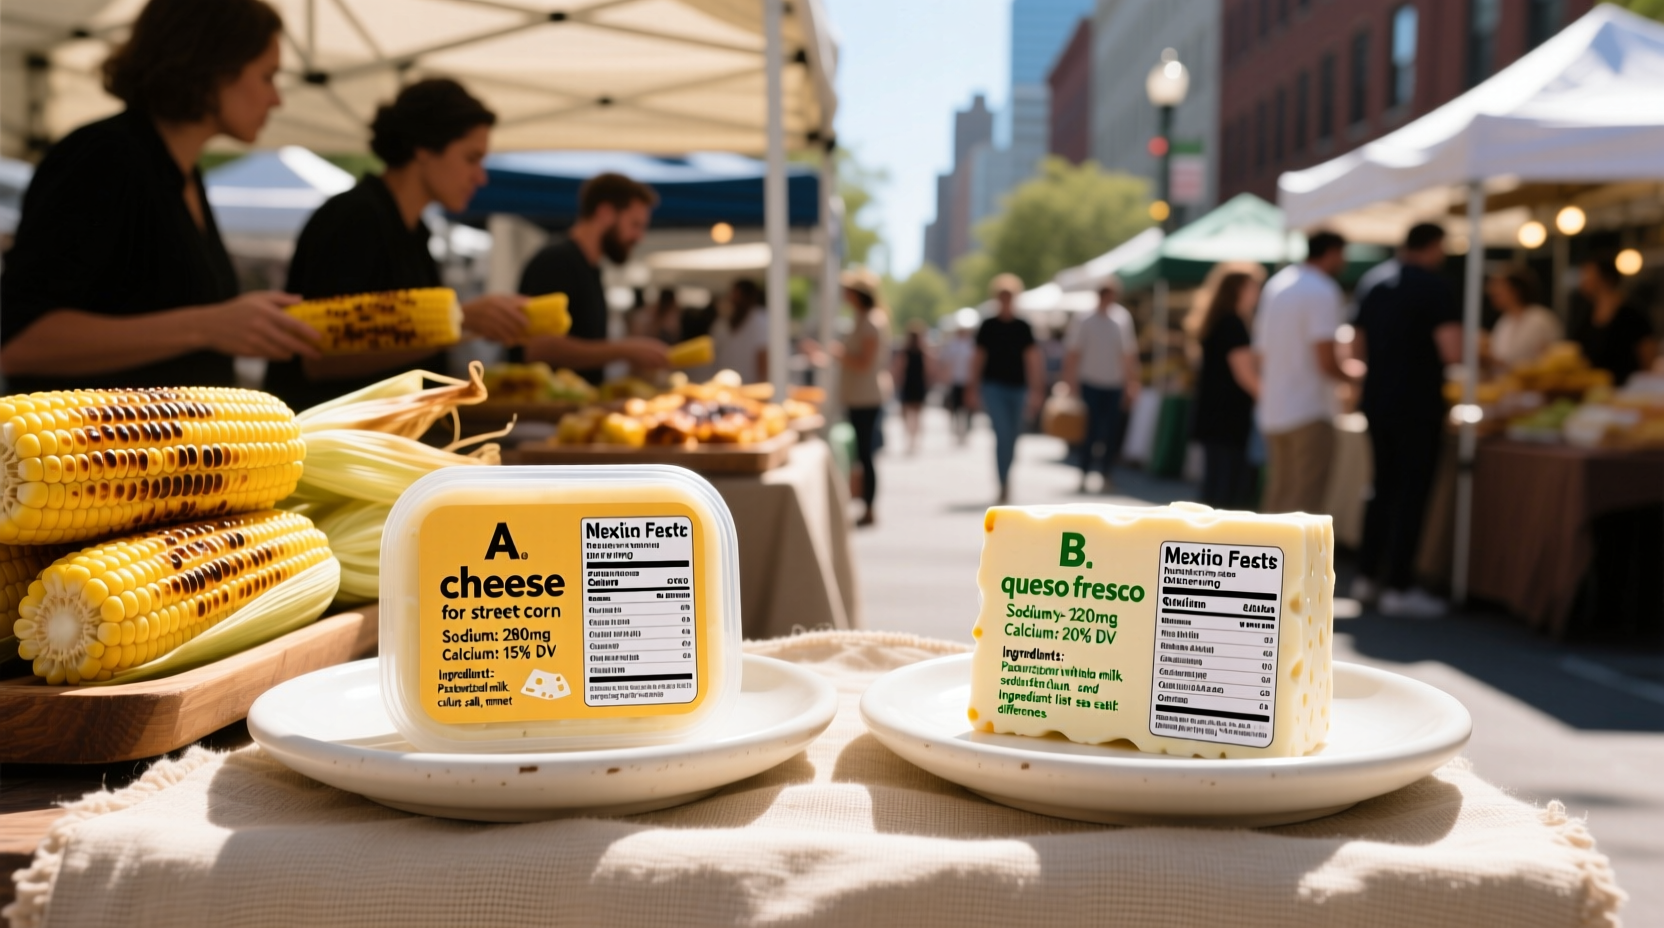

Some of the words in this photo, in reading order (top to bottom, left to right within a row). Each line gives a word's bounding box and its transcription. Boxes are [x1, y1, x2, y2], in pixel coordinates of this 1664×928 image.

[1059, 532, 1093, 569] B.
[440, 566, 565, 598] cheese
[1001, 576, 1069, 599] queso
[1073, 575, 1145, 603] fresco
[442, 604, 466, 620] for
[471, 605, 520, 619] street
[524, 606, 561, 618] corn
[442, 628, 499, 643] Sodium:
[1004, 623, 1059, 640] Calcium:
[1062, 627, 1092, 643] 20%
[1096, 629, 1117, 645] DV
[442, 647, 499, 661] Calcium:
[503, 645, 531, 660] 15%
[536, 644, 556, 658] DV
